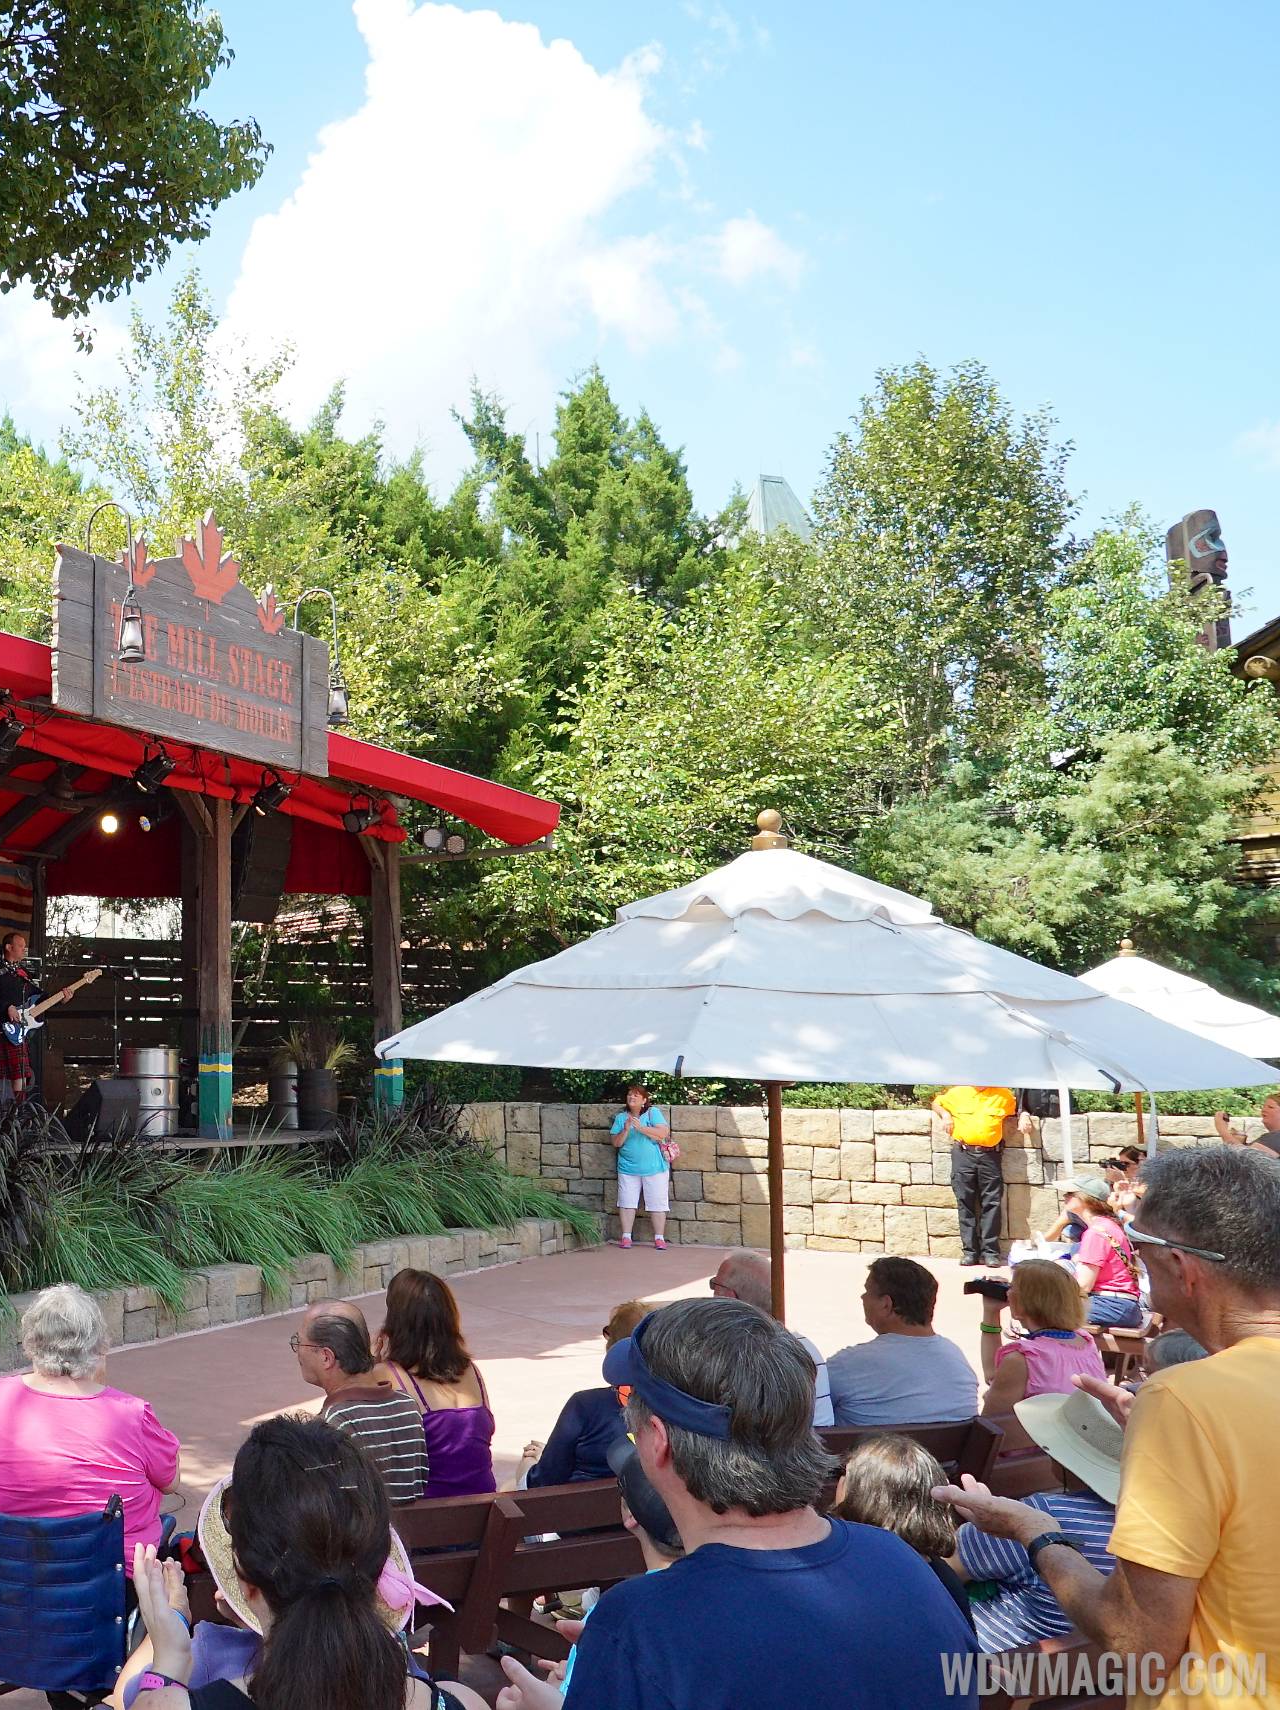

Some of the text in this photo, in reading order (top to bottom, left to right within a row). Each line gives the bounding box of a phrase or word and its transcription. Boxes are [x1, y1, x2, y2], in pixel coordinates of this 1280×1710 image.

[110, 604, 294, 705] TE MILL STAGE
[209, 690, 231, 727] DU
